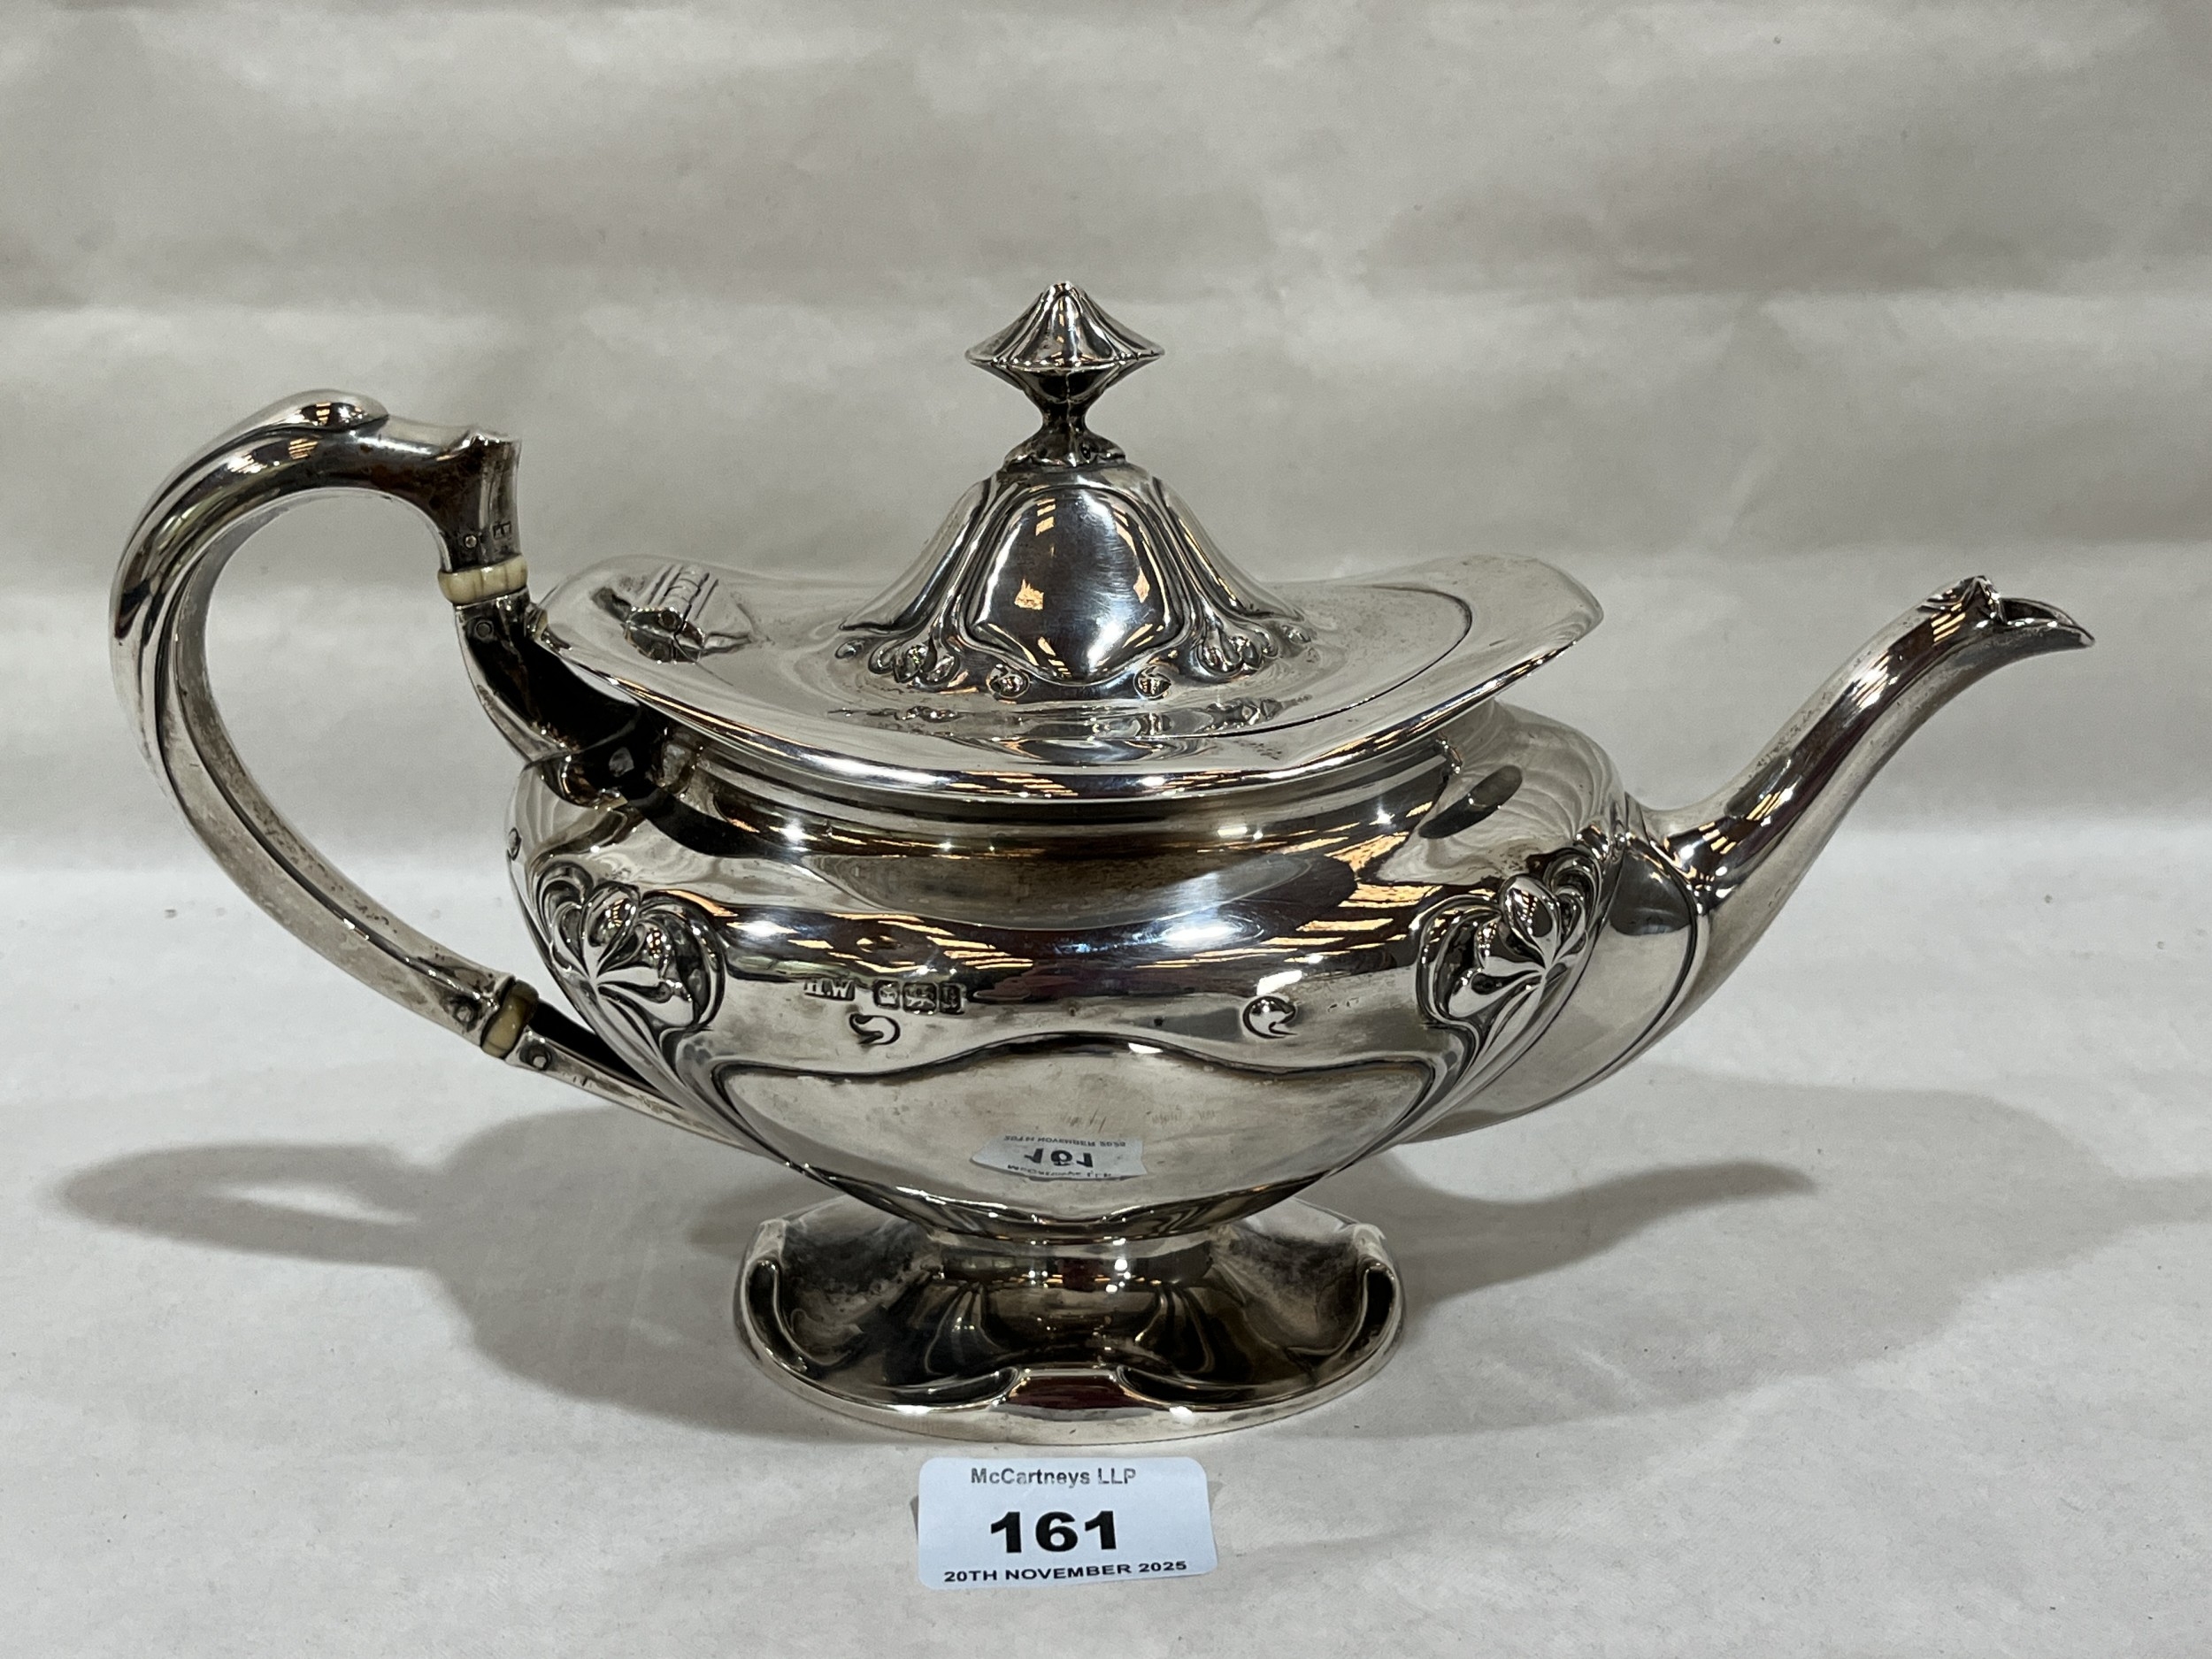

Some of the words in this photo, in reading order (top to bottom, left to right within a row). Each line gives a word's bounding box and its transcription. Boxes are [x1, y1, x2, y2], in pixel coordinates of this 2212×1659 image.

[971, 1467, 1090, 1488] McCartneys
[1097, 1468, 1136, 1485] LLP
[990, 1510, 1117, 1554] 161
[944, 1571, 997, 1582] 20TH
[1005, 1563, 1132, 1580] NOVEMBER
[1138, 1560, 1187, 1573] 2025
